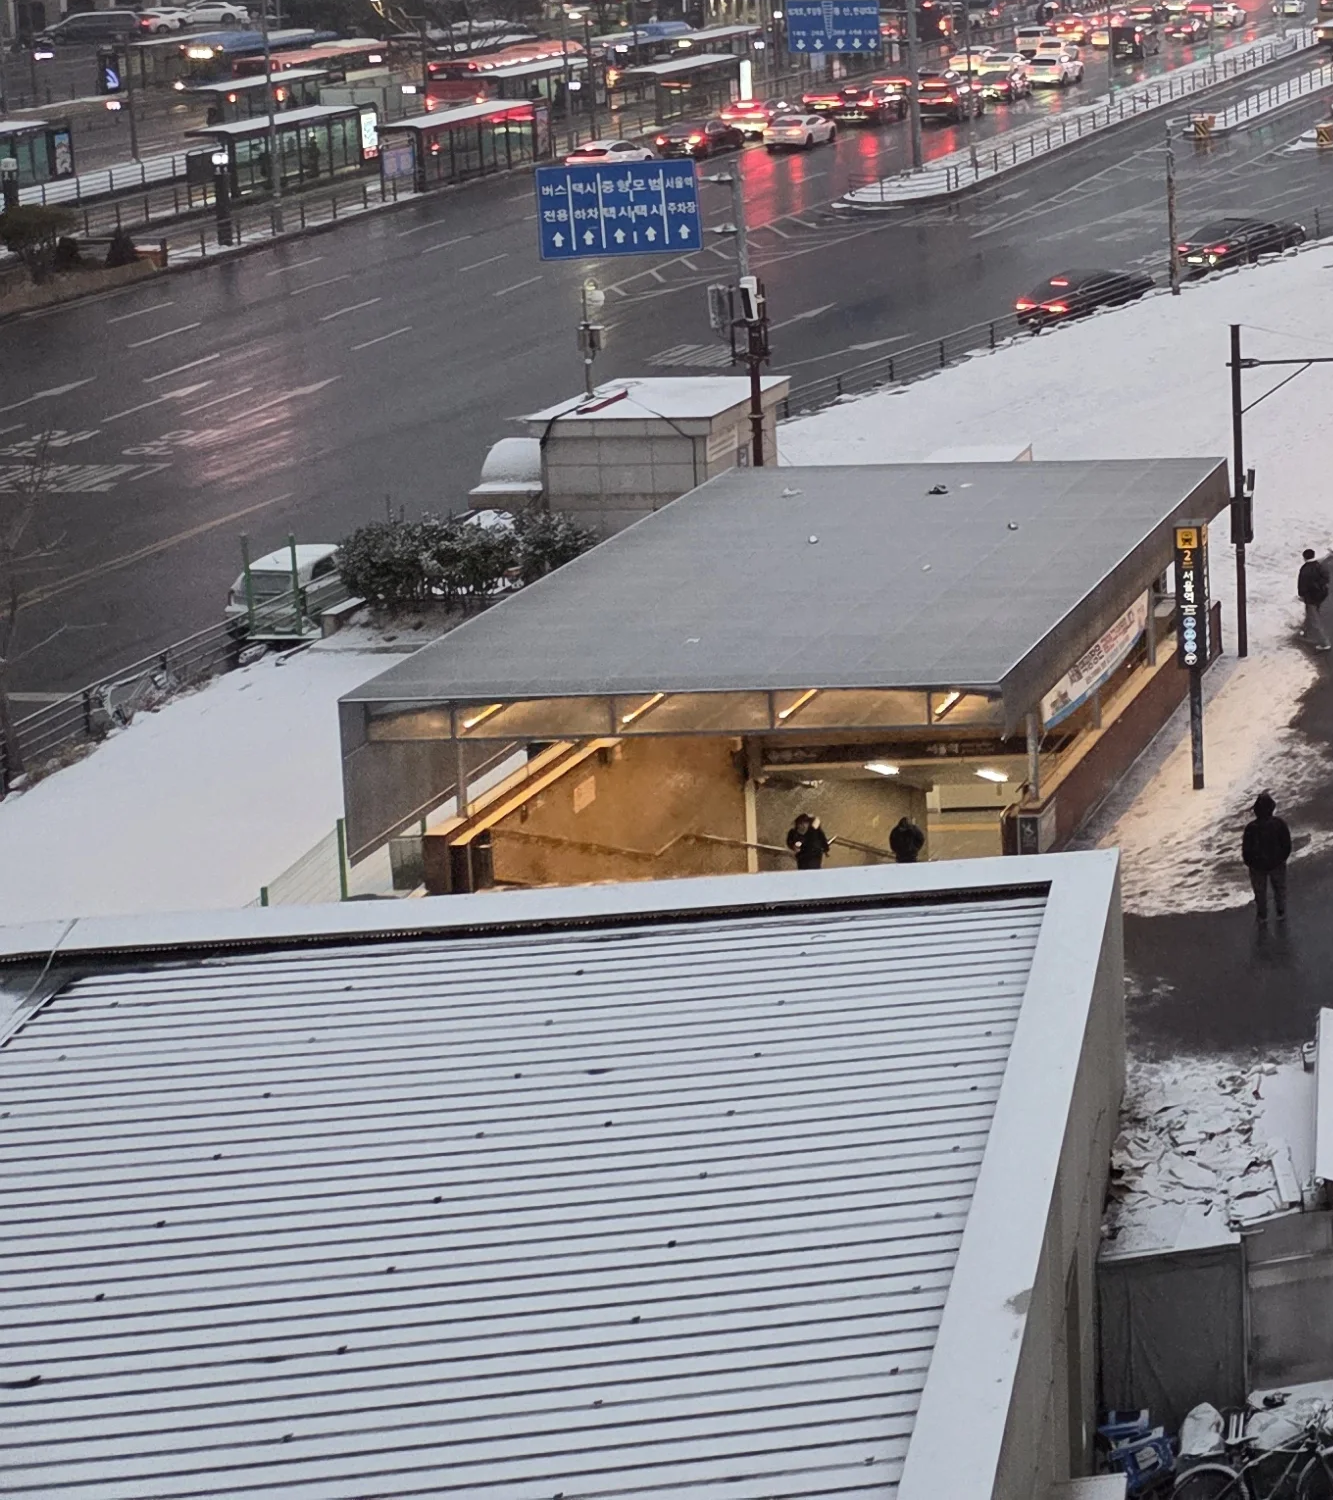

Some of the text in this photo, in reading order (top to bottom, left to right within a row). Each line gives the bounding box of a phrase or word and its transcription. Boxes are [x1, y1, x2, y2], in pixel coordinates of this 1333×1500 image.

[572, 182, 596, 195] 택시
[666, 175, 694, 189] 서울역
[541, 184, 567, 197] 버스
[574, 207, 599, 220] 하차
[668, 201, 697, 214] 주차장
[543, 209, 569, 222] 전용
[1183, 549, 1191, 561] 2
[1182, 570, 1195, 604] 서울역
